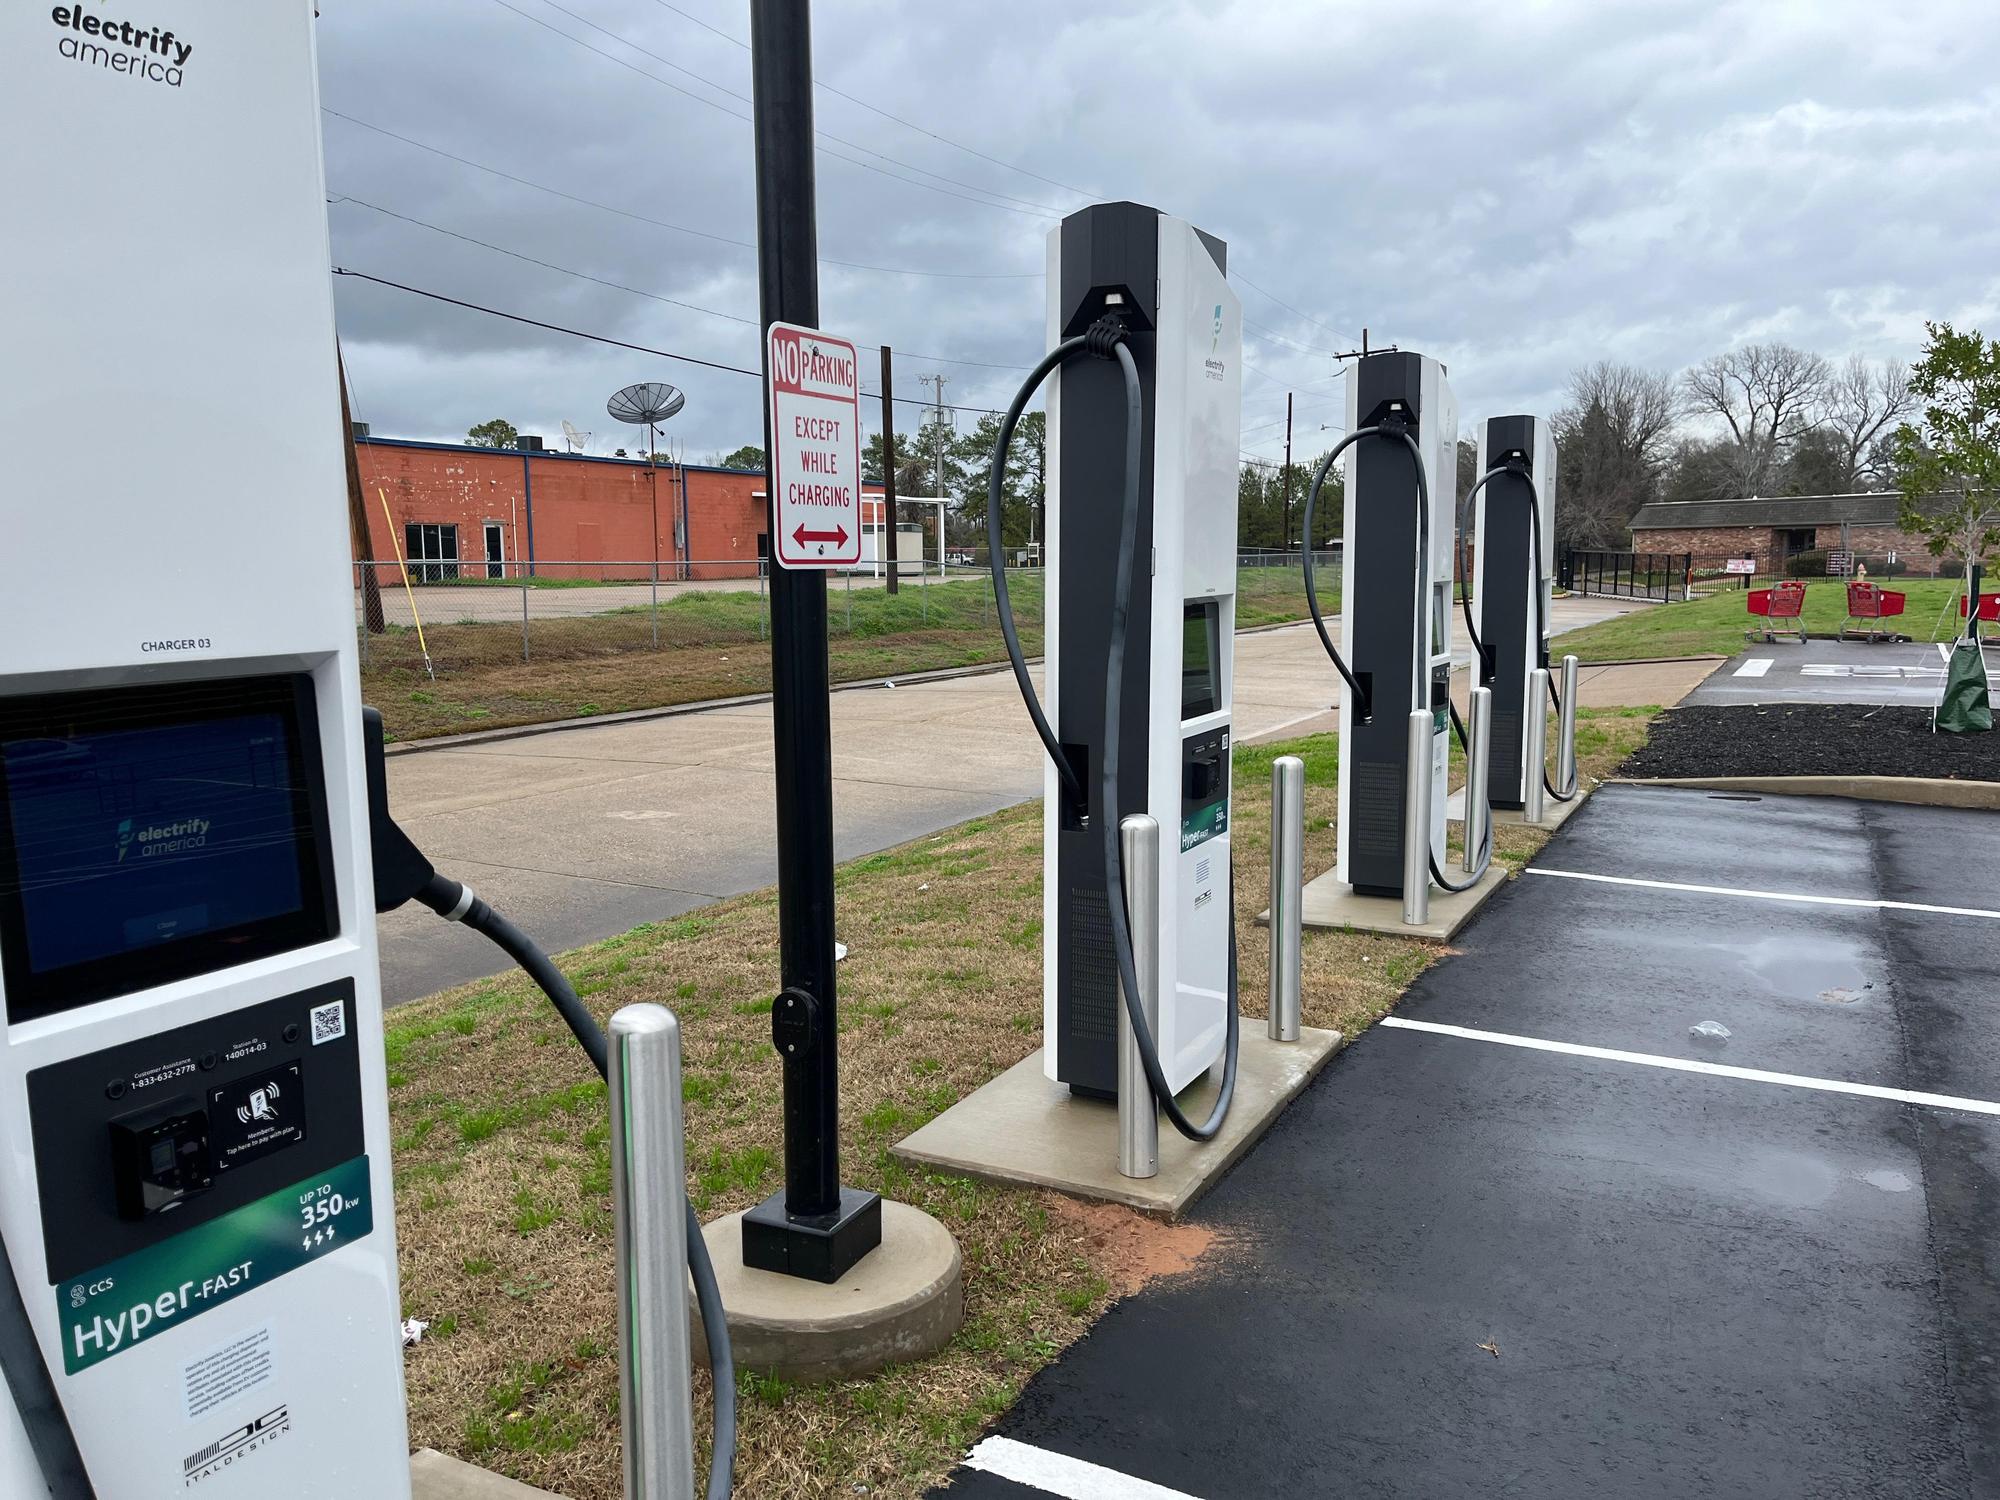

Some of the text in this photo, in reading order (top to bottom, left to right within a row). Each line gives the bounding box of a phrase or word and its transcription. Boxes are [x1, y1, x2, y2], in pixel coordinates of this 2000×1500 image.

[52, 4, 192, 66] electrify
[59, 38, 183, 87] america
[773, 338, 853, 388] NO PARKING
[795, 416, 840, 442] EXCEPT
[801, 450, 837, 475] WHILE
[789, 483, 850, 508] CHARGING
[141, 638, 211, 652] CHARGER 03
[138, 819, 210, 842] electrify
[142, 836, 206, 857] america
[225, 1042, 267, 1061] 140014-03
[131, 1063, 196, 1090] 1-833-632-2778
[134, 1058, 192, 1079] Customer Assistance
[299, 1184, 331, 1205] UP TO
[301, 1193, 343, 1229] 350
[88, 1277, 114, 1296] CCS
[185, 1424, 290, 1488] ITALDESIGN
